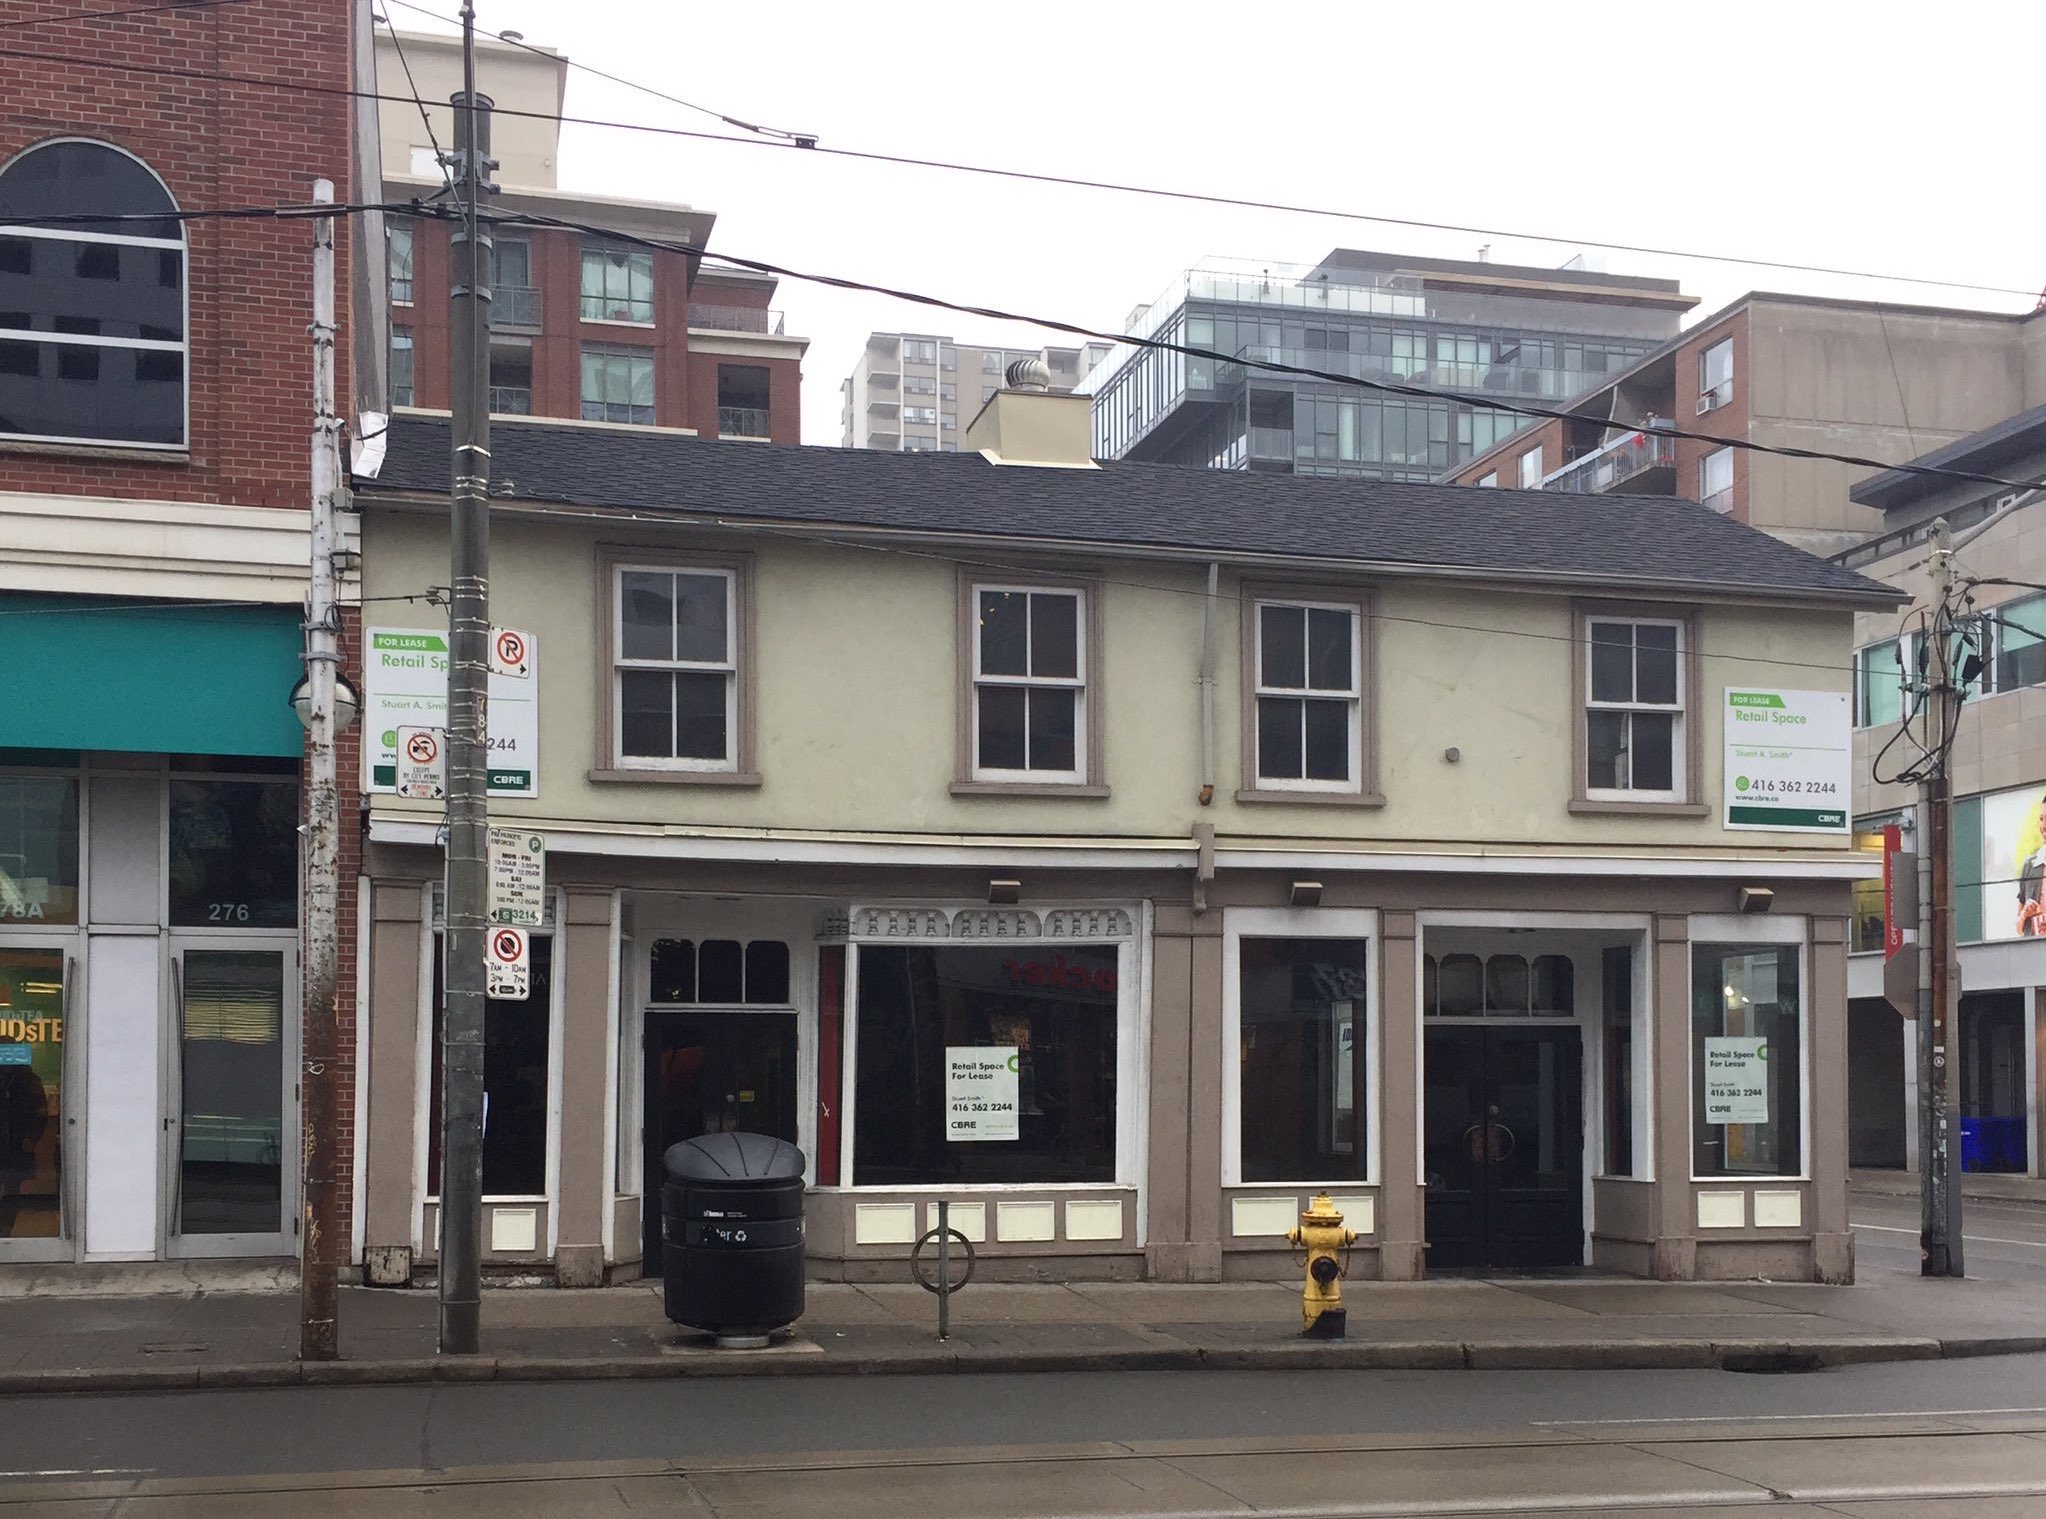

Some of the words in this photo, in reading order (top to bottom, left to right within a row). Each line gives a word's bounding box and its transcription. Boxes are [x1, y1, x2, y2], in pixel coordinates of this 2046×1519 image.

[379, 637, 398, 646] FOR
[400, 638, 427, 648] LEASE
[381, 653, 425, 668] Retail
[382, 700, 410, 710] Stuart
[414, 701, 423, 710] A.
[427, 701, 448, 711] Smit
[1734, 696, 1748, 704] FOR
[1749, 697, 1770, 705] LEASE
[1735, 710, 1768, 722] Retail
[1772, 711, 1807, 725] Space
[487, 738, 517, 751] 244
[493, 776, 524, 785] CBRE
[1752, 779, 1775, 792] 416
[1779, 780, 1802, 793] 362
[1806, 781, 1836, 794] 2244
[1818, 814, 1841, 823] CBRE
[502, 852, 517, 860] MON
[208, 903, 250, 921] 276
[513, 909, 536, 920] 3214
[489, 961, 502, 972] 7AM
[512, 963, 527, 973] 10AM
[490, 973, 504, 983] 3PM
[514, 974, 526, 984] 7PM
[1709, 1051, 1732, 1059] Retail
[1733, 1051, 1755, 1060] Space
[951, 1062, 977, 1071] Retail
[979, 1062, 1005, 1072] Space
[1709, 1060, 1722, 1068] For
[1724, 1060, 1746, 1068] Lease
[951, 1072, 967, 1080] For
[968, 1072, 994, 1080] Lease
[1710, 1089, 1725, 1097] 416
[1727, 1089, 1741, 1097] 362
[1743, 1088, 1763, 1097] 2244
[952, 1103, 969, 1112] 416
[971, 1103, 989, 1112] 362
[991, 1102, 1013, 1112] 2244
[1709, 1105, 1732, 1113] CBRE
[950, 1121, 977, 1129] CBRE
